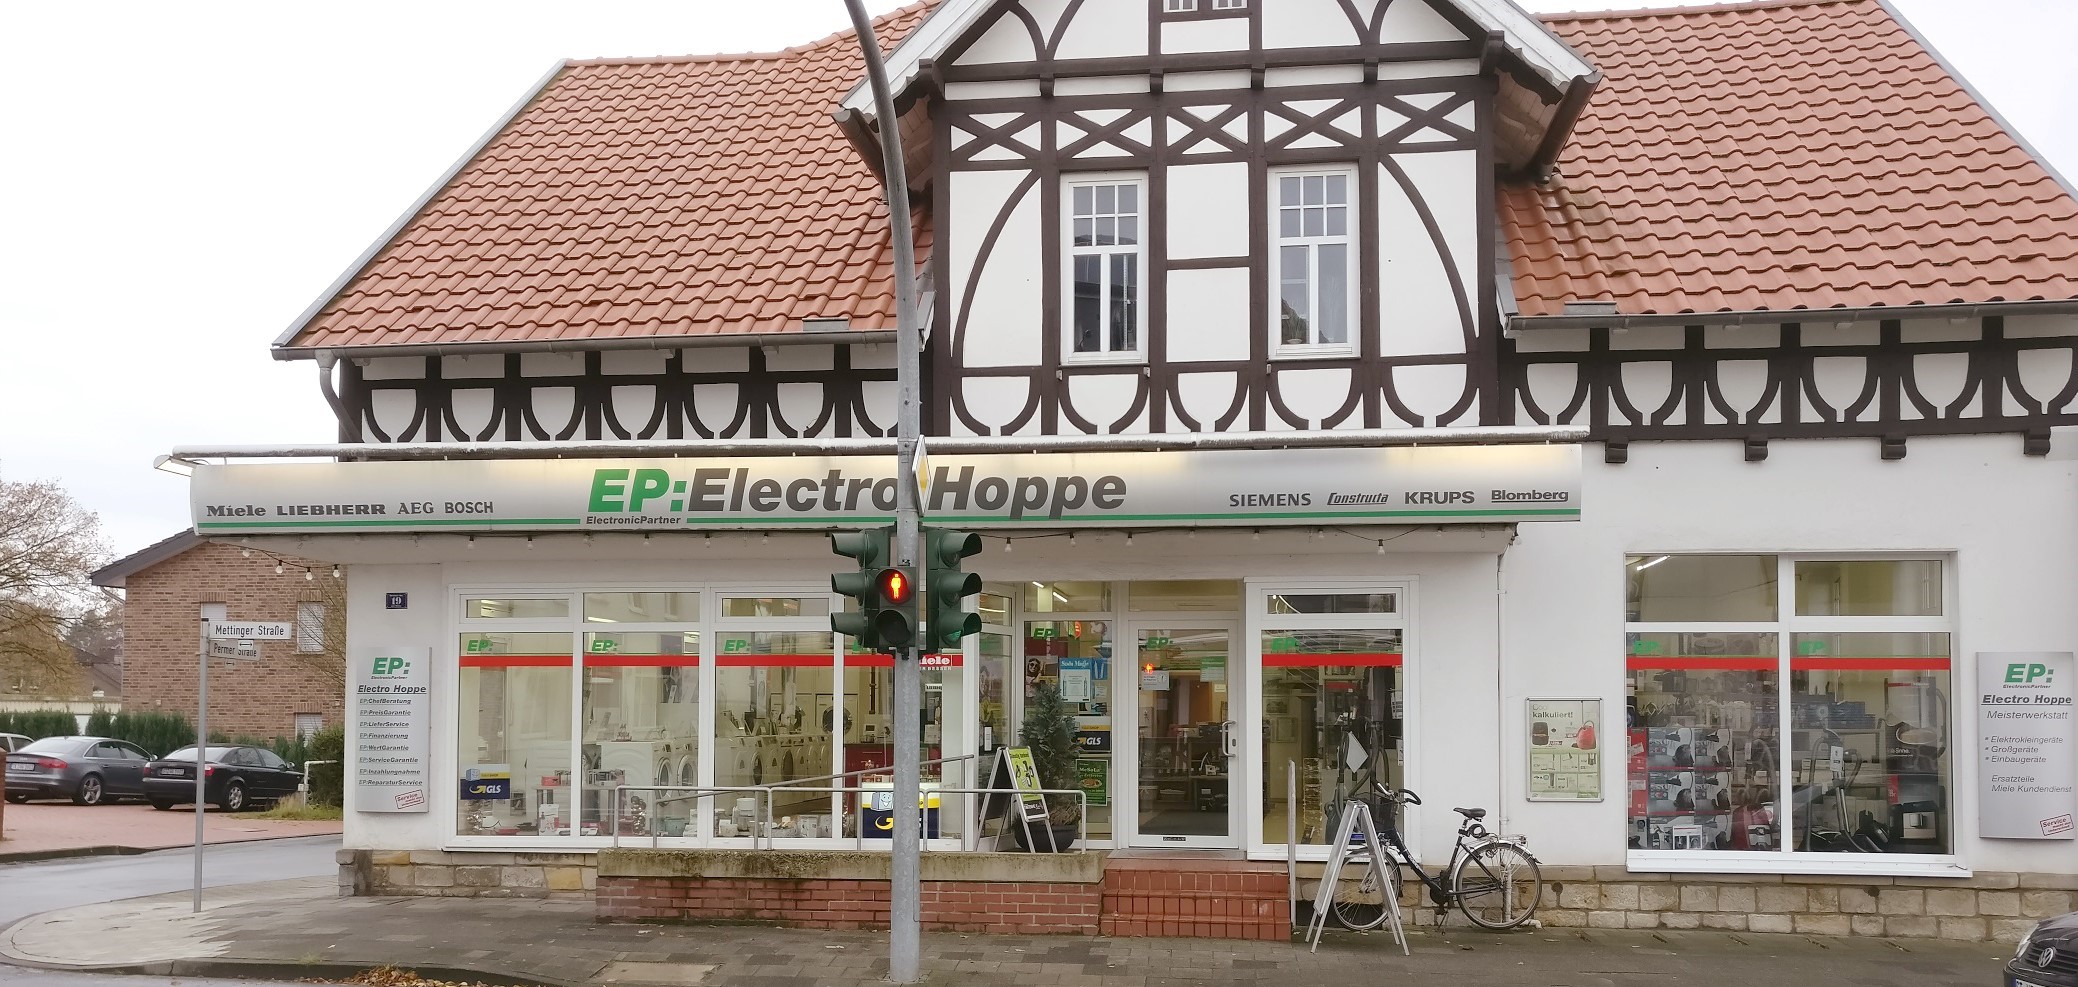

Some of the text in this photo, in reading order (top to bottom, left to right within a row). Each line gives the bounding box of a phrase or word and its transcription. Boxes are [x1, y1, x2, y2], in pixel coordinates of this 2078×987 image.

[928, 465, 1127, 520] Hoppe
[1404, 491, 1475, 504] KRUPS
[1491, 489, 1569, 502] Blomberg
[1229, 493, 1312, 507] SIEMENS
[206, 505, 266, 517] Miele
[276, 503, 386, 516] LIEBHERR
[397, 502, 434, 515] AEG
[444, 501, 494, 515] BOSCH
[586, 516, 681, 525] ElectronicPartner
[392, 596, 401, 605] 19
[215, 625, 285, 638] Mettinger Straße
[213, 643, 235, 655] Permer
[372, 657, 411, 675] EP:
[920, 656, 950, 665] iele
[2004, 663, 2054, 683] EP:
[358, 685, 427, 694] Electro Hoppe
[1982, 694, 2072, 705] Electro Hoppe
[1987, 710, 2068, 720] Meisterwerkstatt
[1086, 737, 1101, 745] GLS
[1992, 775, 2035, 783] Ersatzteile
[487, 785, 501, 793] GLS
[2017, 785, 2072, 793] Kundendienst
